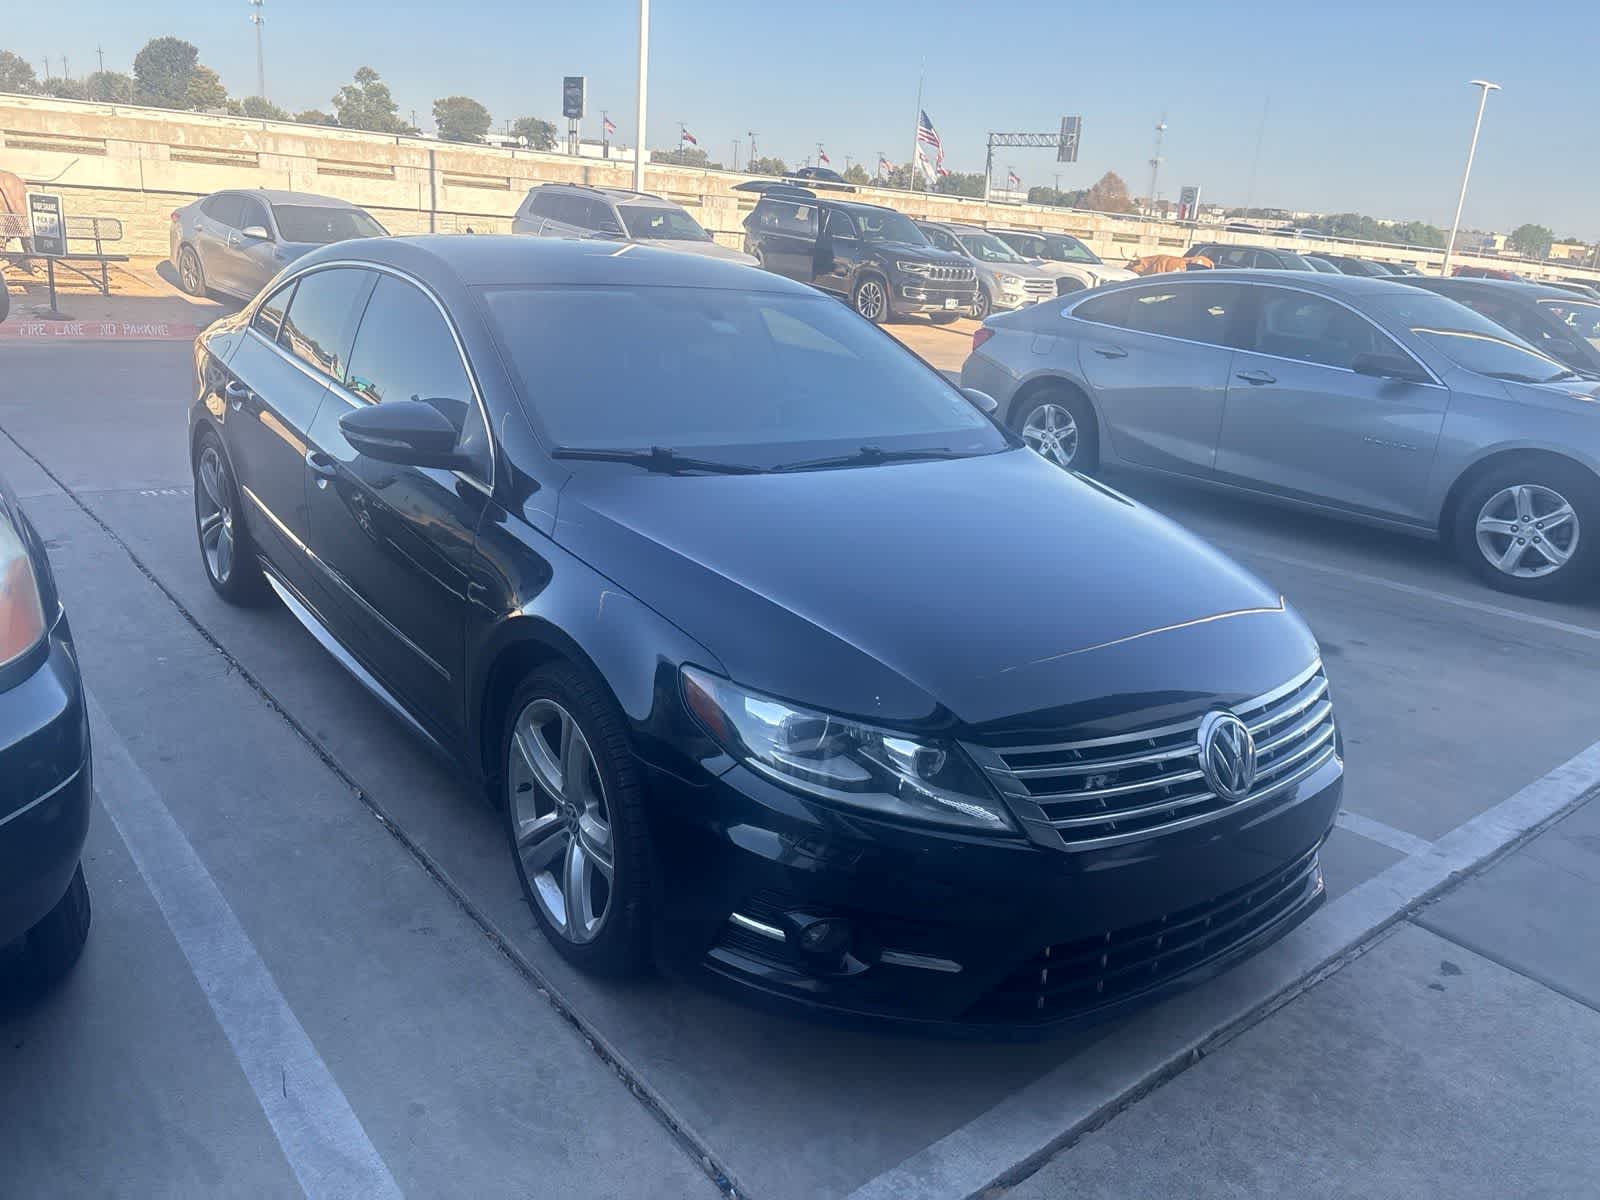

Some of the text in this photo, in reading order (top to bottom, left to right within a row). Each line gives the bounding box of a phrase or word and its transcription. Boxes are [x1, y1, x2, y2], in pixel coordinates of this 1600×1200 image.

[18, 323, 169, 336] FIRE LANE NO PARKING
[1202, 713, 1255, 798] VW
